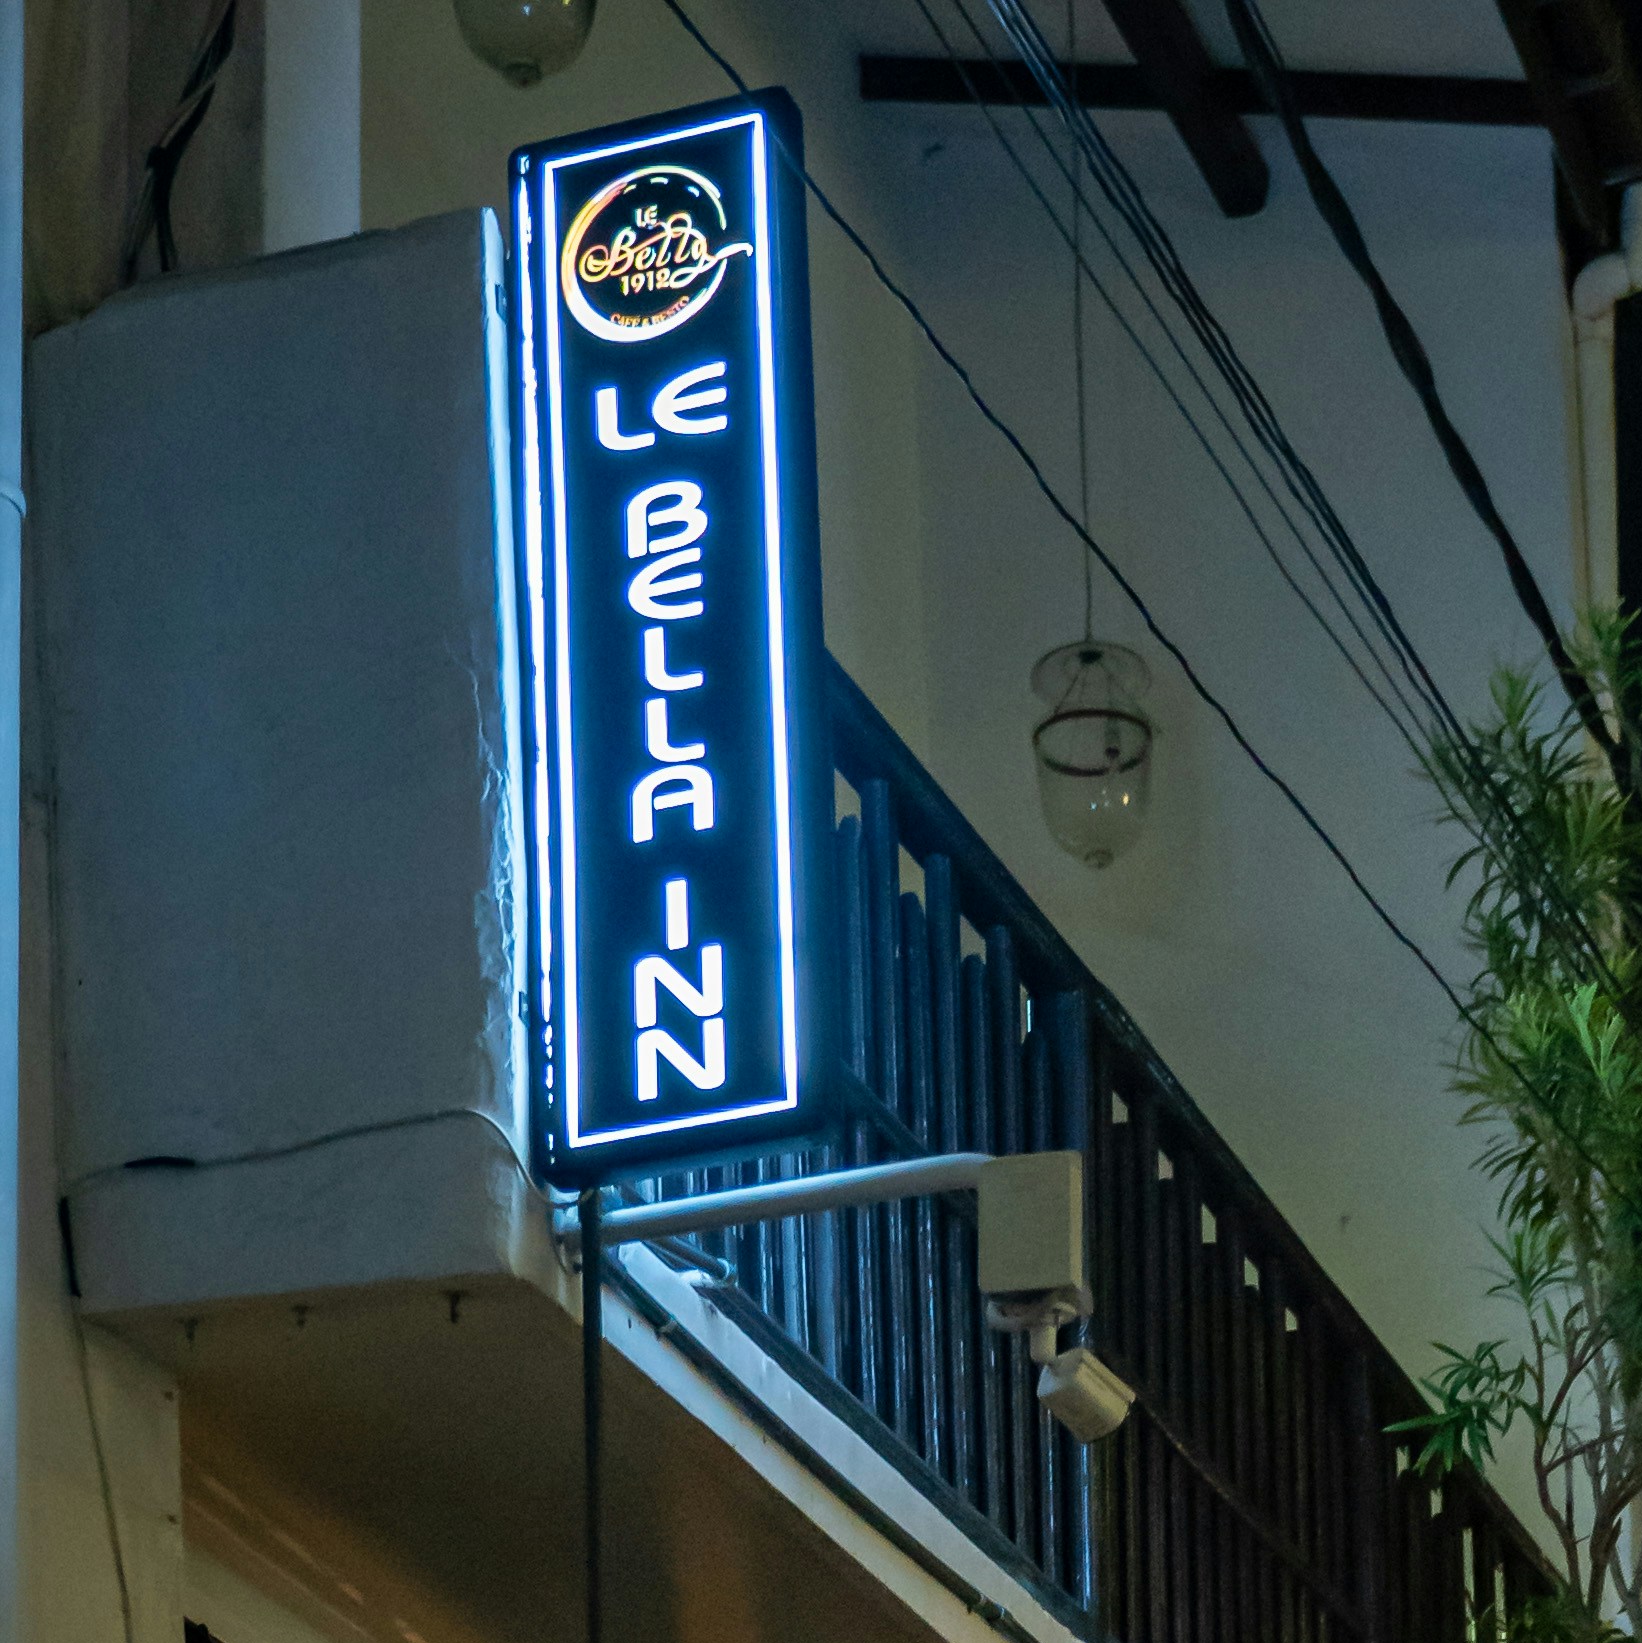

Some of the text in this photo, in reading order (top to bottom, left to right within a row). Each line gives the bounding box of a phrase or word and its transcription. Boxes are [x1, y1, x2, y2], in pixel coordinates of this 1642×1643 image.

[636, 206, 658, 227] LE
[620, 267, 671, 297] 1912
[596, 361, 728, 452] LE
[626, 479, 715, 844] BELLA
[634, 877, 726, 1103] INN
